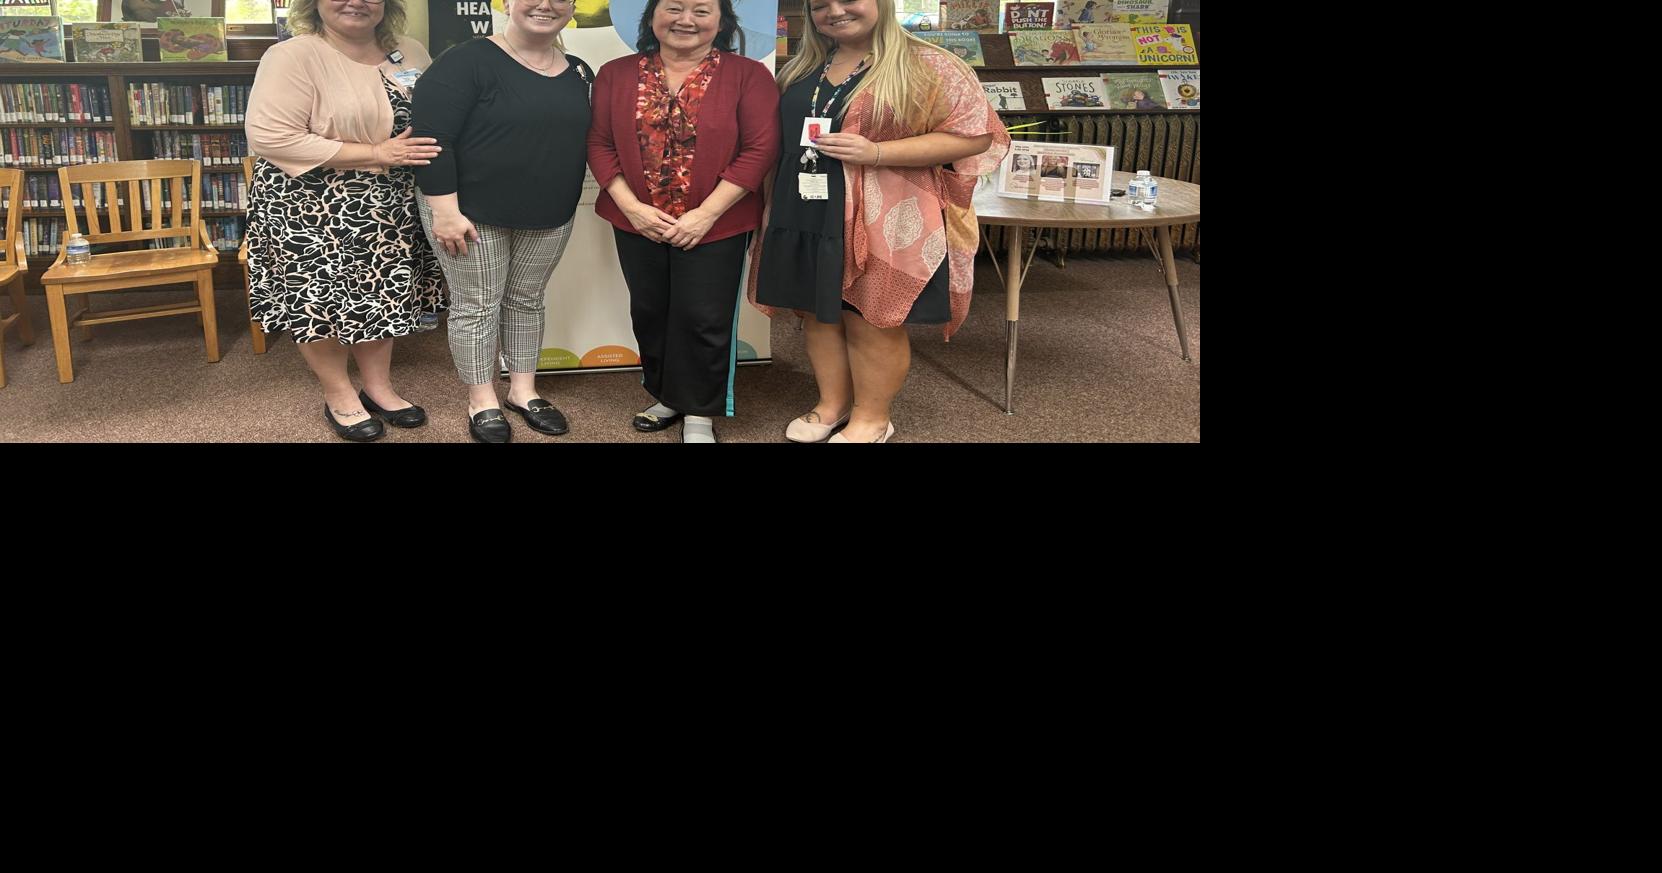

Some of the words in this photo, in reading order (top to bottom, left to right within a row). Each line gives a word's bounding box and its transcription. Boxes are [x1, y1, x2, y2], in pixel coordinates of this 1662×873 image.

[1136, 26, 1161, 34] THIS
[1138, 34, 1160, 45] NOT
[1146, 46, 1154, 54] A
[1139, 54, 1196, 63] UNICORN!
[1055, 81, 1096, 94] STONES
